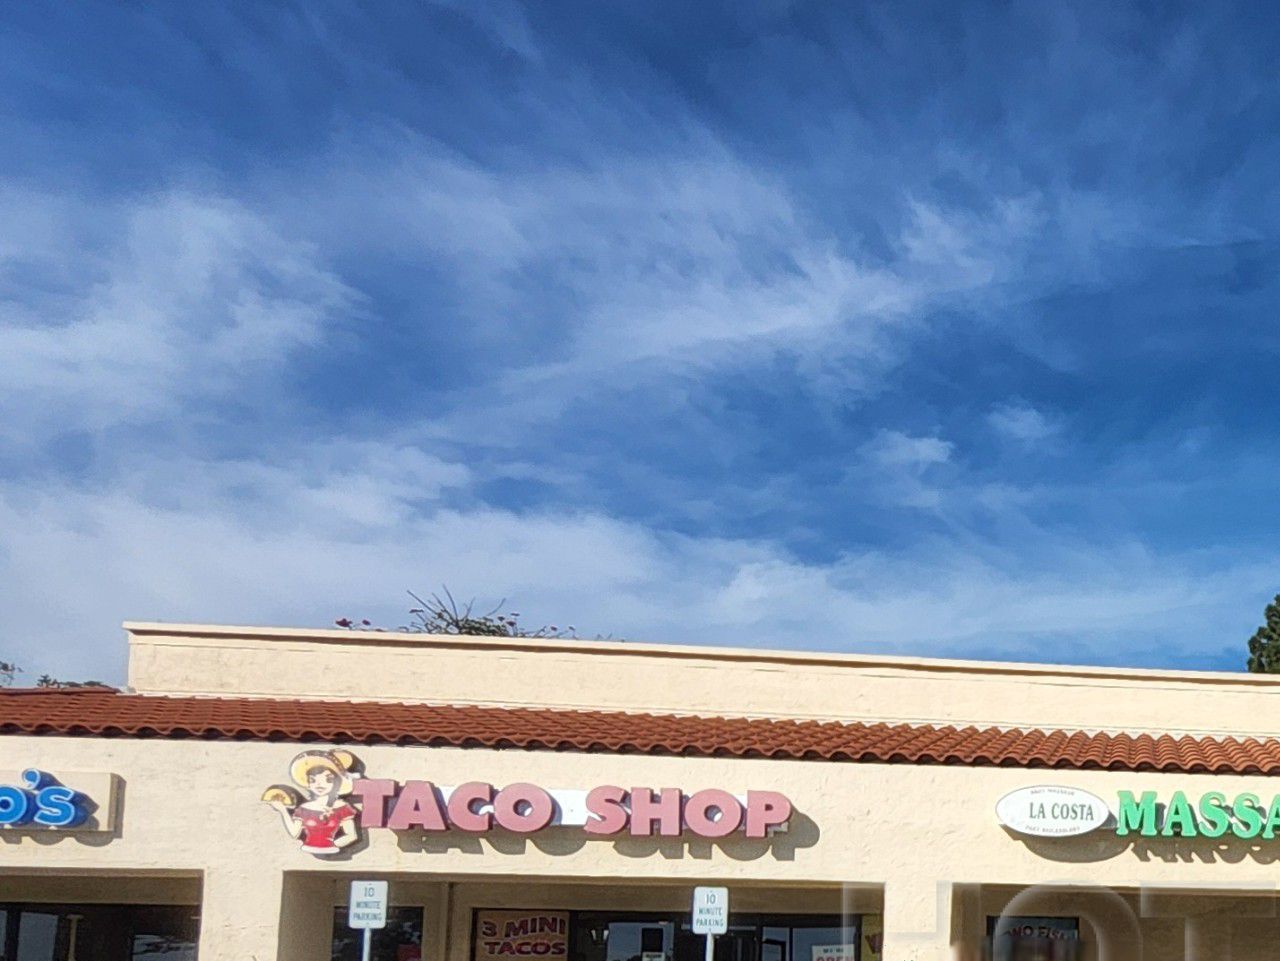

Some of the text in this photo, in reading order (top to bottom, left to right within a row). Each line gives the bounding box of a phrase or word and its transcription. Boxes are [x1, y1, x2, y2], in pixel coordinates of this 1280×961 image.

[352, 778, 792, 838] TACO SHOP
[1029, 802, 1094, 821] LA COSTA
[705, 894, 717, 905] 10
[353, 912, 382, 921] PARKING
[699, 907, 722, 916] MINUTE
[481, 916, 566, 938] 3 MINI
[696, 918, 724, 927] PARKING
[484, 941, 567, 955] TACOS
